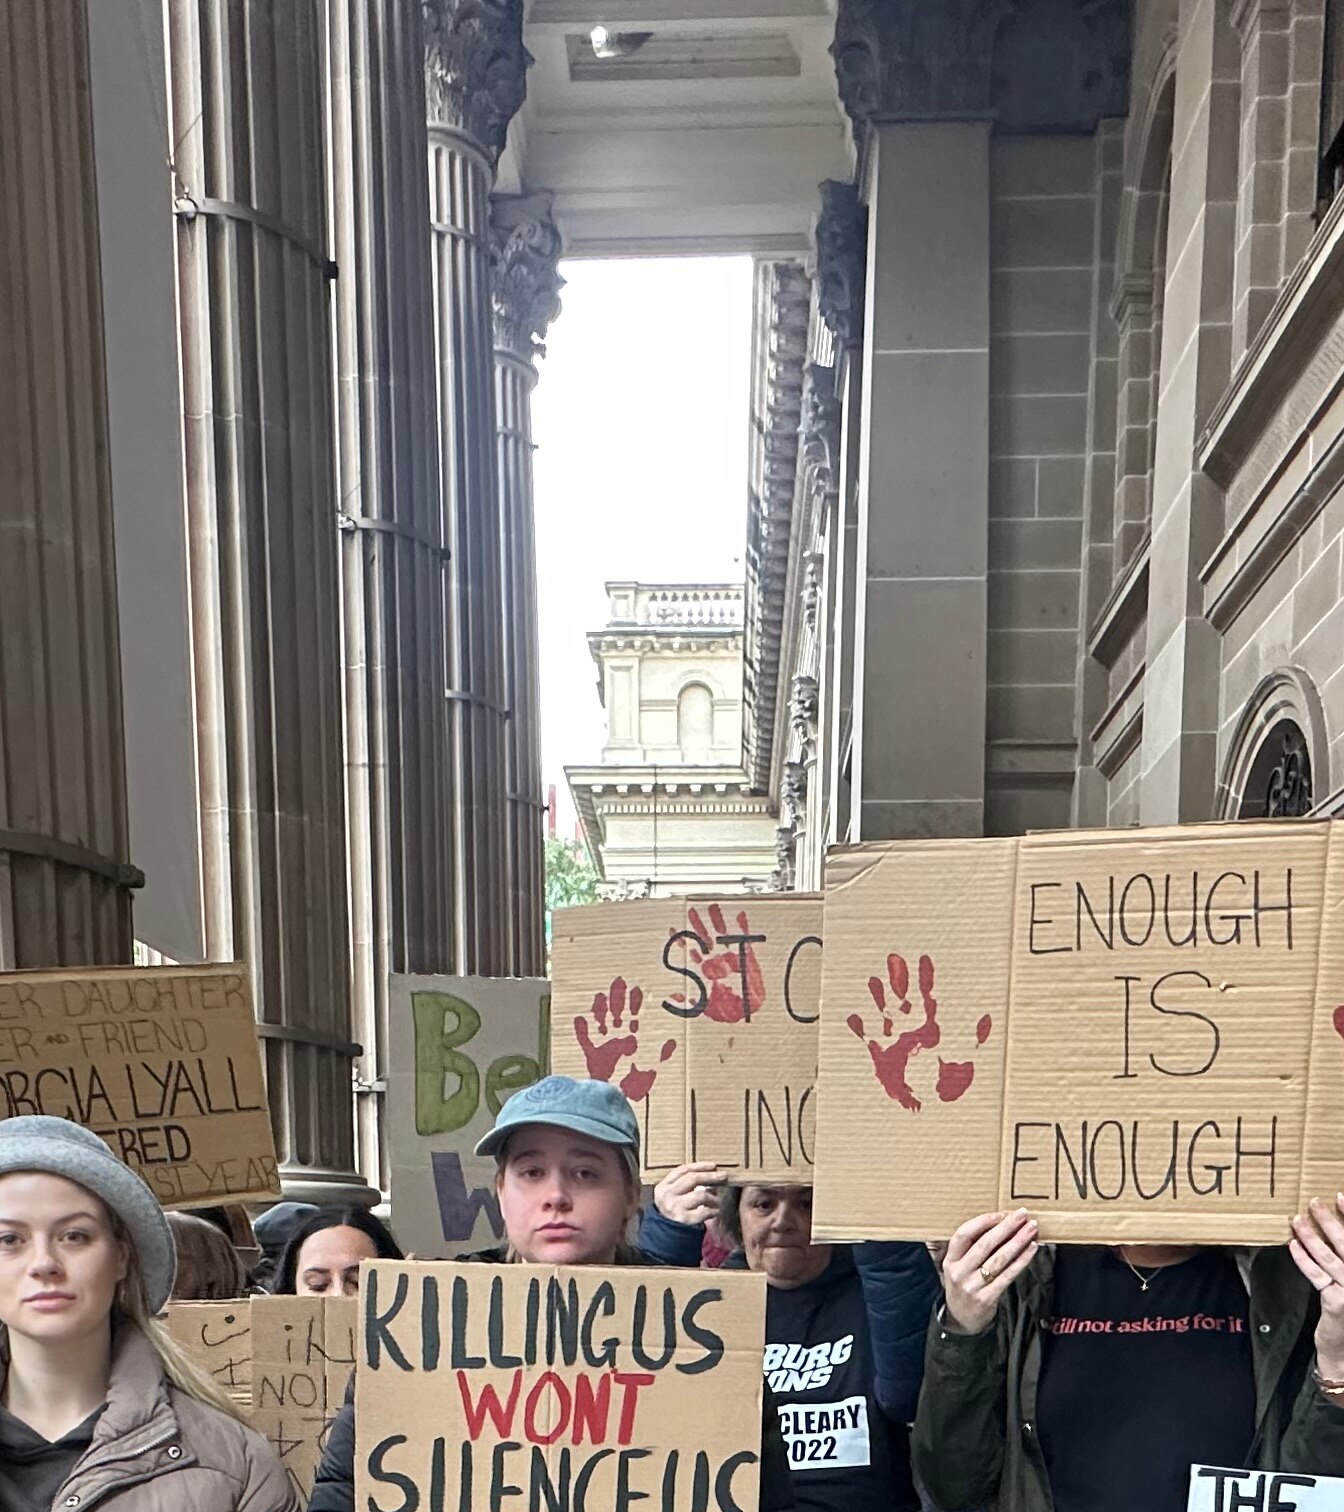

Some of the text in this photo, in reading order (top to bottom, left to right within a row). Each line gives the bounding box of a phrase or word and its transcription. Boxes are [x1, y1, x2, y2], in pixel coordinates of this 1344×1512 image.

[1030, 868, 1294, 955] ENOUGH
[61, 974, 246, 1018] DAUGHTER
[1113, 970, 1221, 1079] IS
[77, 1018, 208, 1057] FRIEND
[126, 1056, 261, 1119] LYALL
[1010, 1115, 1278, 1201] ENOUGH
[1079, 1319, 1113, 1333] not
[1116, 1316, 1191, 1333] asking
[1193, 1313, 1225, 1330] for
[1228, 1316, 1243, 1333] it
